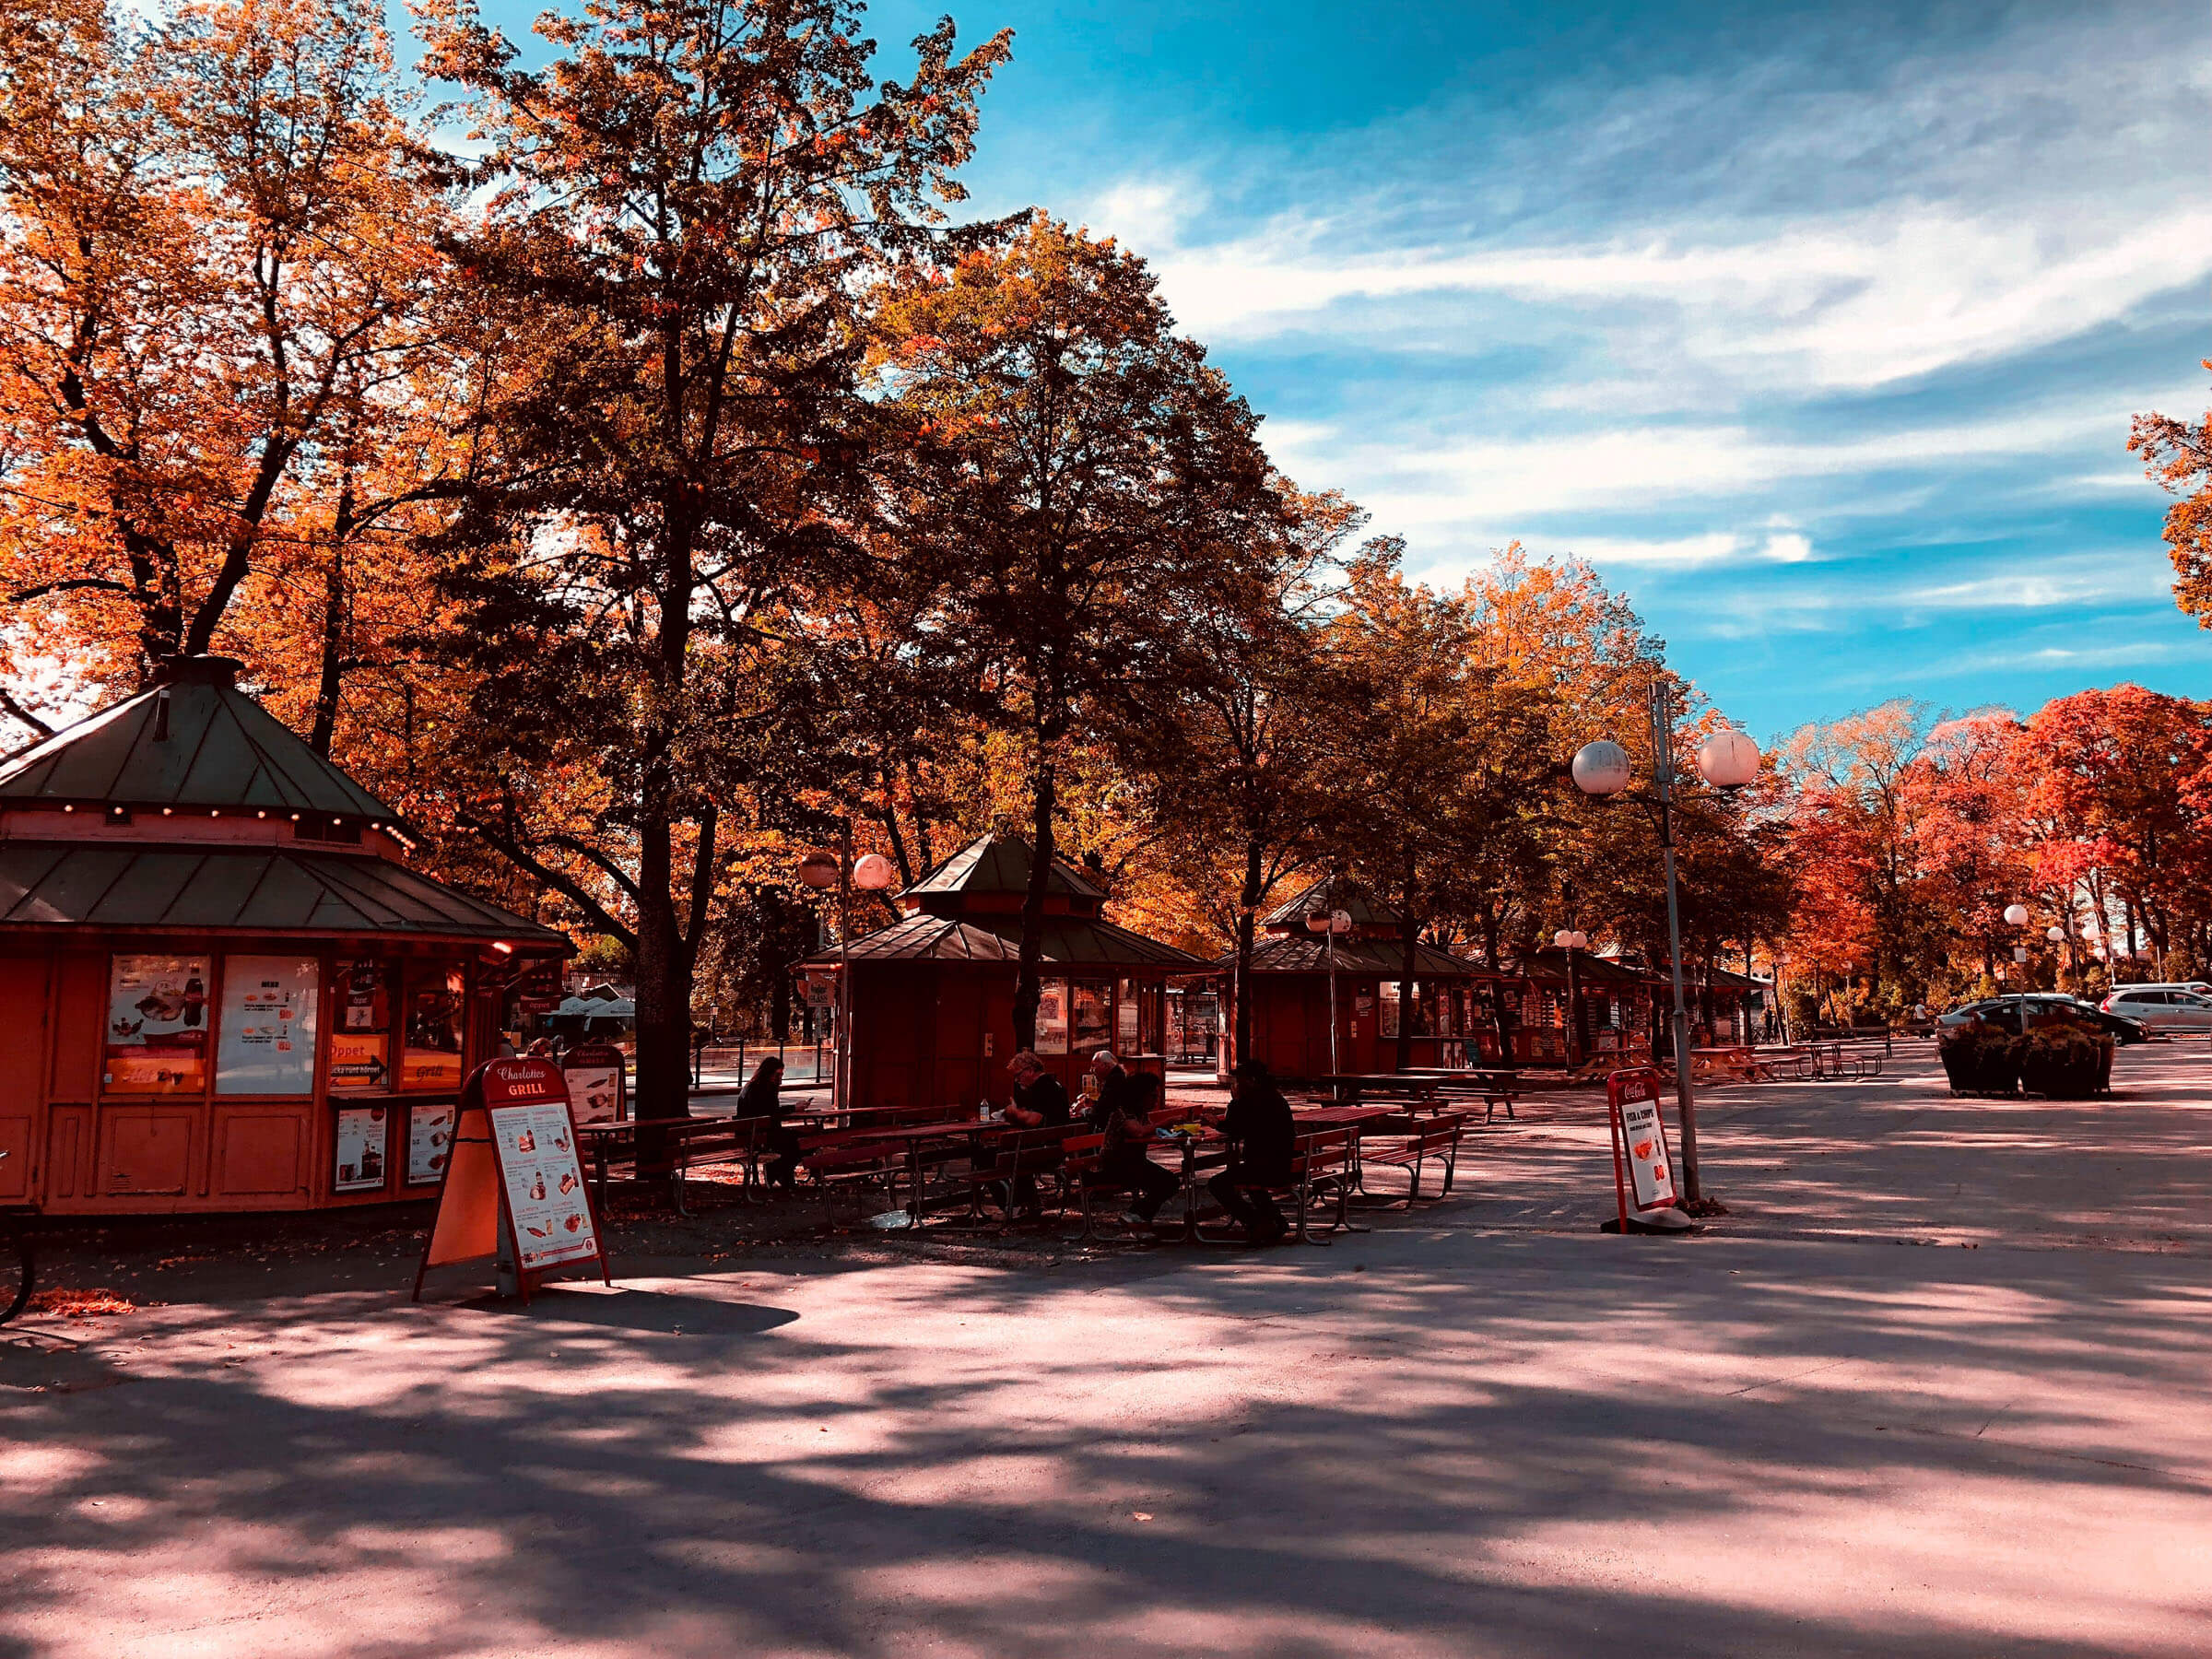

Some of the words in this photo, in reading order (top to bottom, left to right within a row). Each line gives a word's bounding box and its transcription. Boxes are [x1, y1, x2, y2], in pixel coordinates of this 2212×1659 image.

[345, 1065, 359, 1074] runt
[359, 1065, 381, 1074] hörnet
[497, 1065, 547, 1081] Charlottes
[508, 1083, 546, 1096] GRILL
[1627, 1112, 1637, 1122] FISH
[1641, 1109, 1653, 1119] CHIPS
